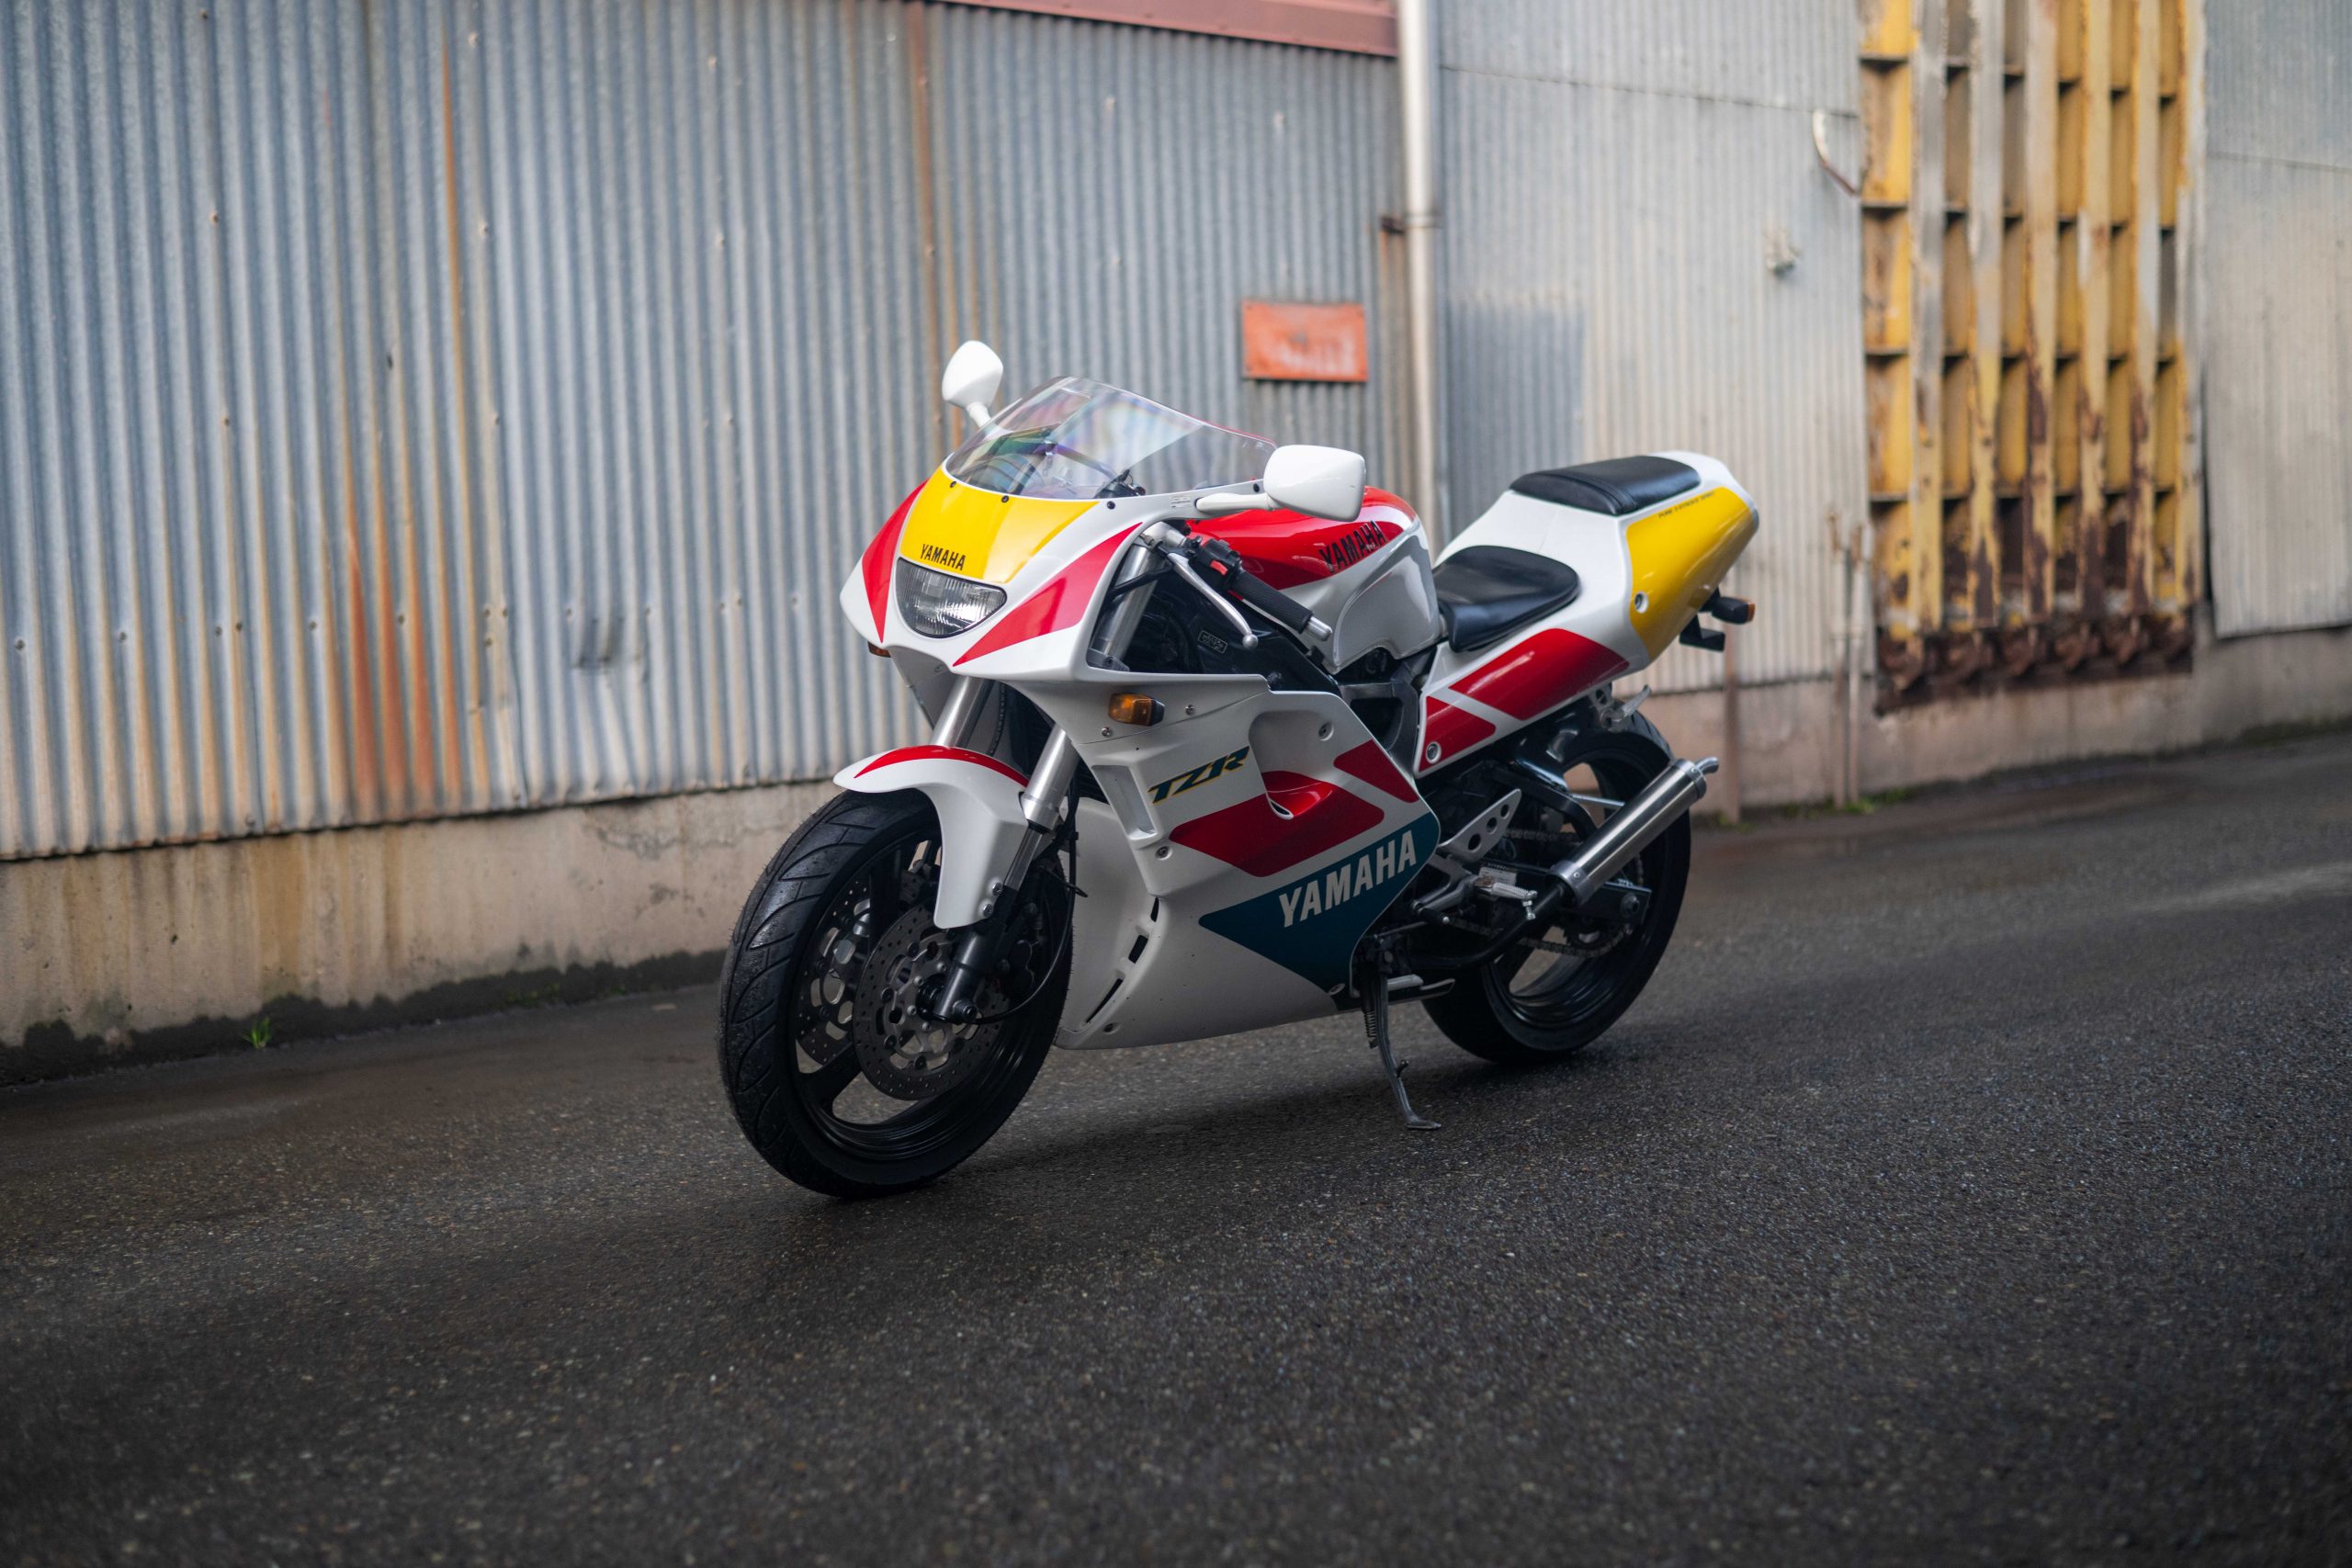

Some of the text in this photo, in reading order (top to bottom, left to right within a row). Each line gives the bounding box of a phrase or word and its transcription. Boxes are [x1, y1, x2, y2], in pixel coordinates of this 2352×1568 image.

[920, 543, 966, 571] YAMAHA
[1317, 520, 1389, 574] YAMAHA
[1147, 745, 1250, 806] TZR
[1278, 829, 1418, 928] YAMAHA
